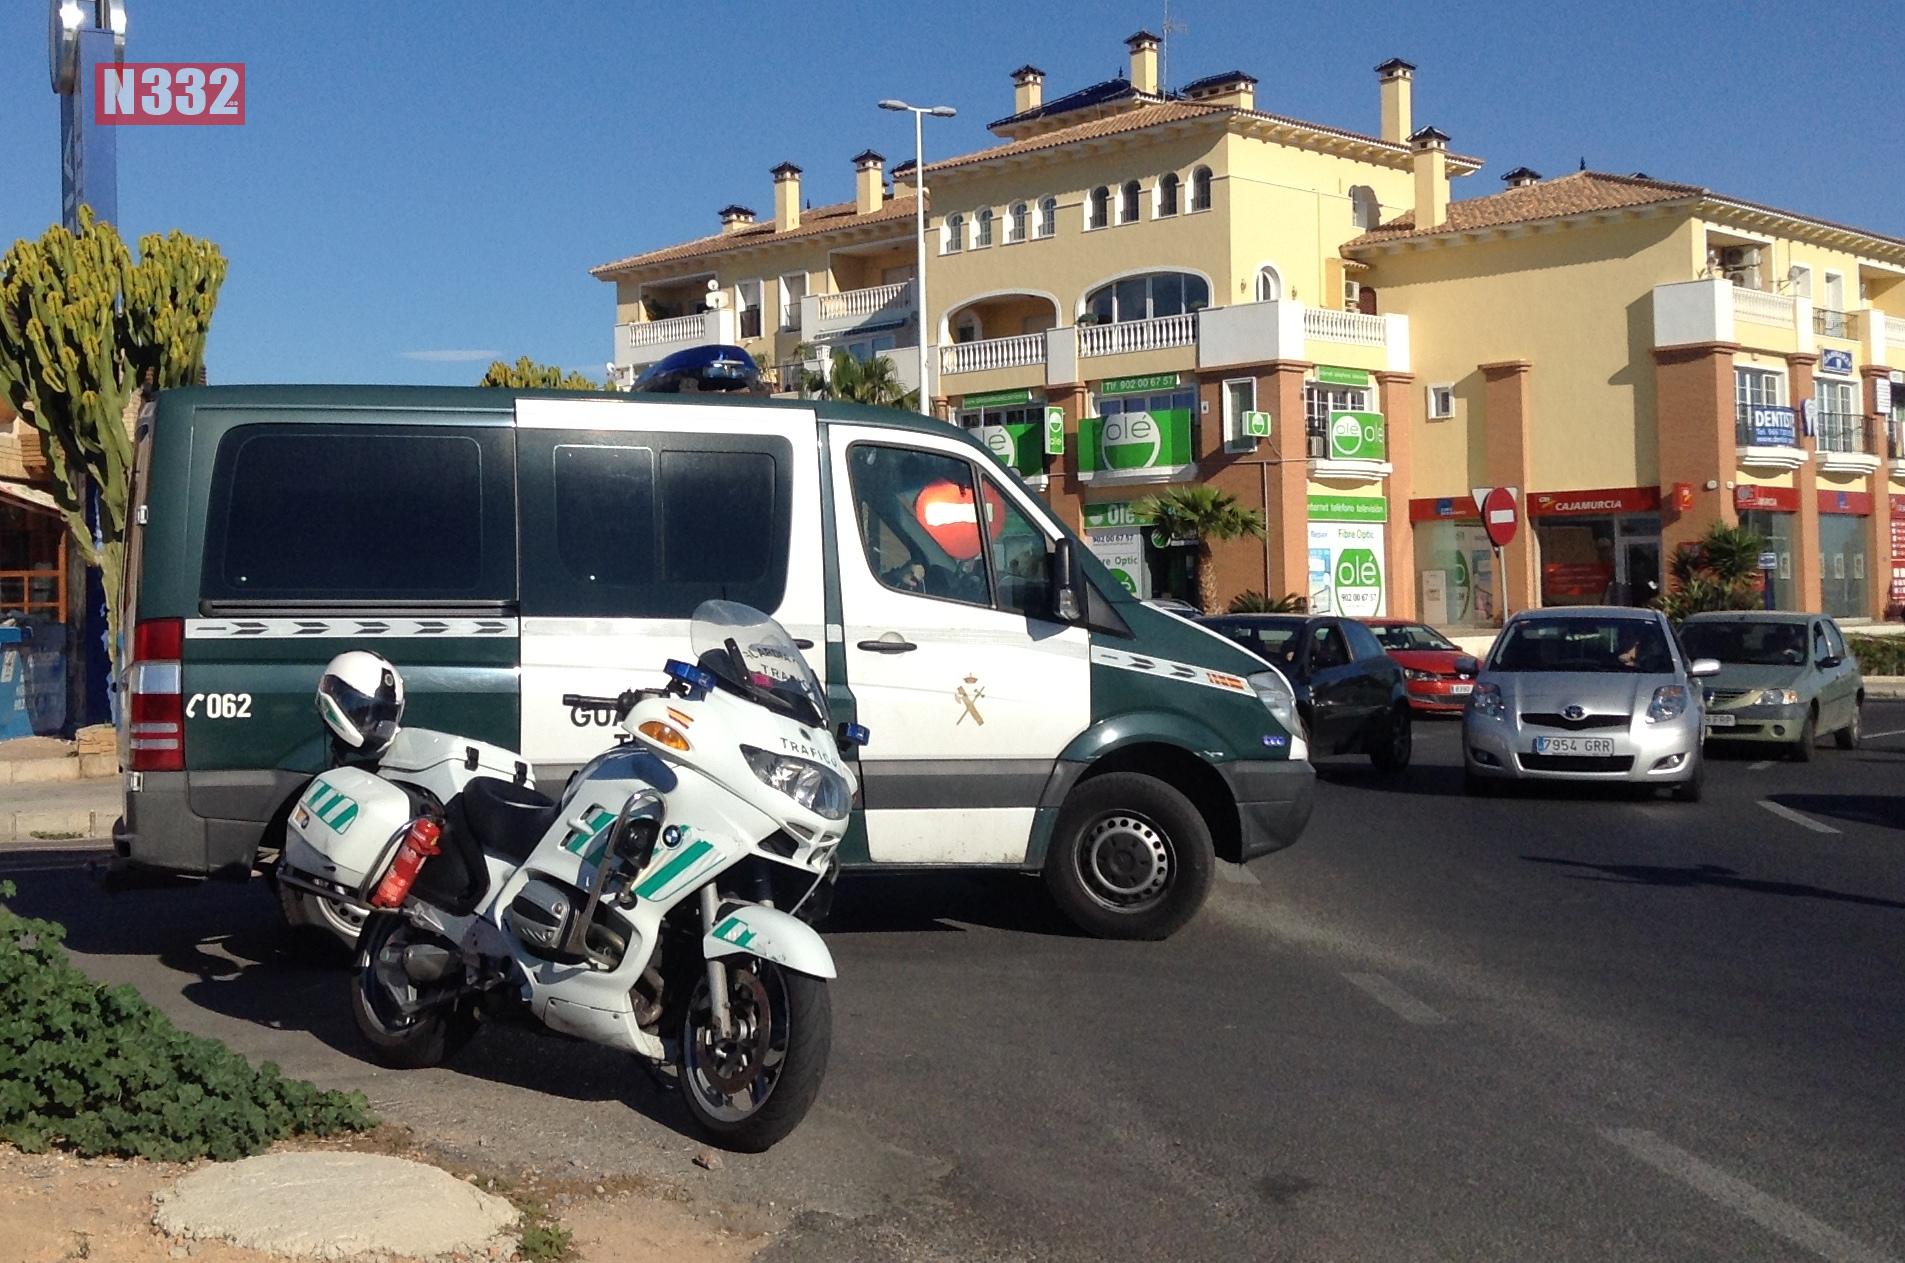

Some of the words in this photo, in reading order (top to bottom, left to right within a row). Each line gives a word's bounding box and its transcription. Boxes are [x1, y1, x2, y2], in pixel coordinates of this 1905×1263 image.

[1120, 379, 1135, 390] 902
[1138, 378, 1149, 388] 00
[1150, 377, 1160, 386] 67
[1164, 375, 1174, 385] 57
[1106, 414, 1151, 441] olé
[1555, 500, 1622, 511] CAJAMURCIA
[1338, 555, 1378, 585] olé
[1341, 593, 1352, 602] 902
[206, 693, 252, 719] 062
[1544, 739, 1577, 751] 7954
[1584, 740, 1611, 752] GRR
